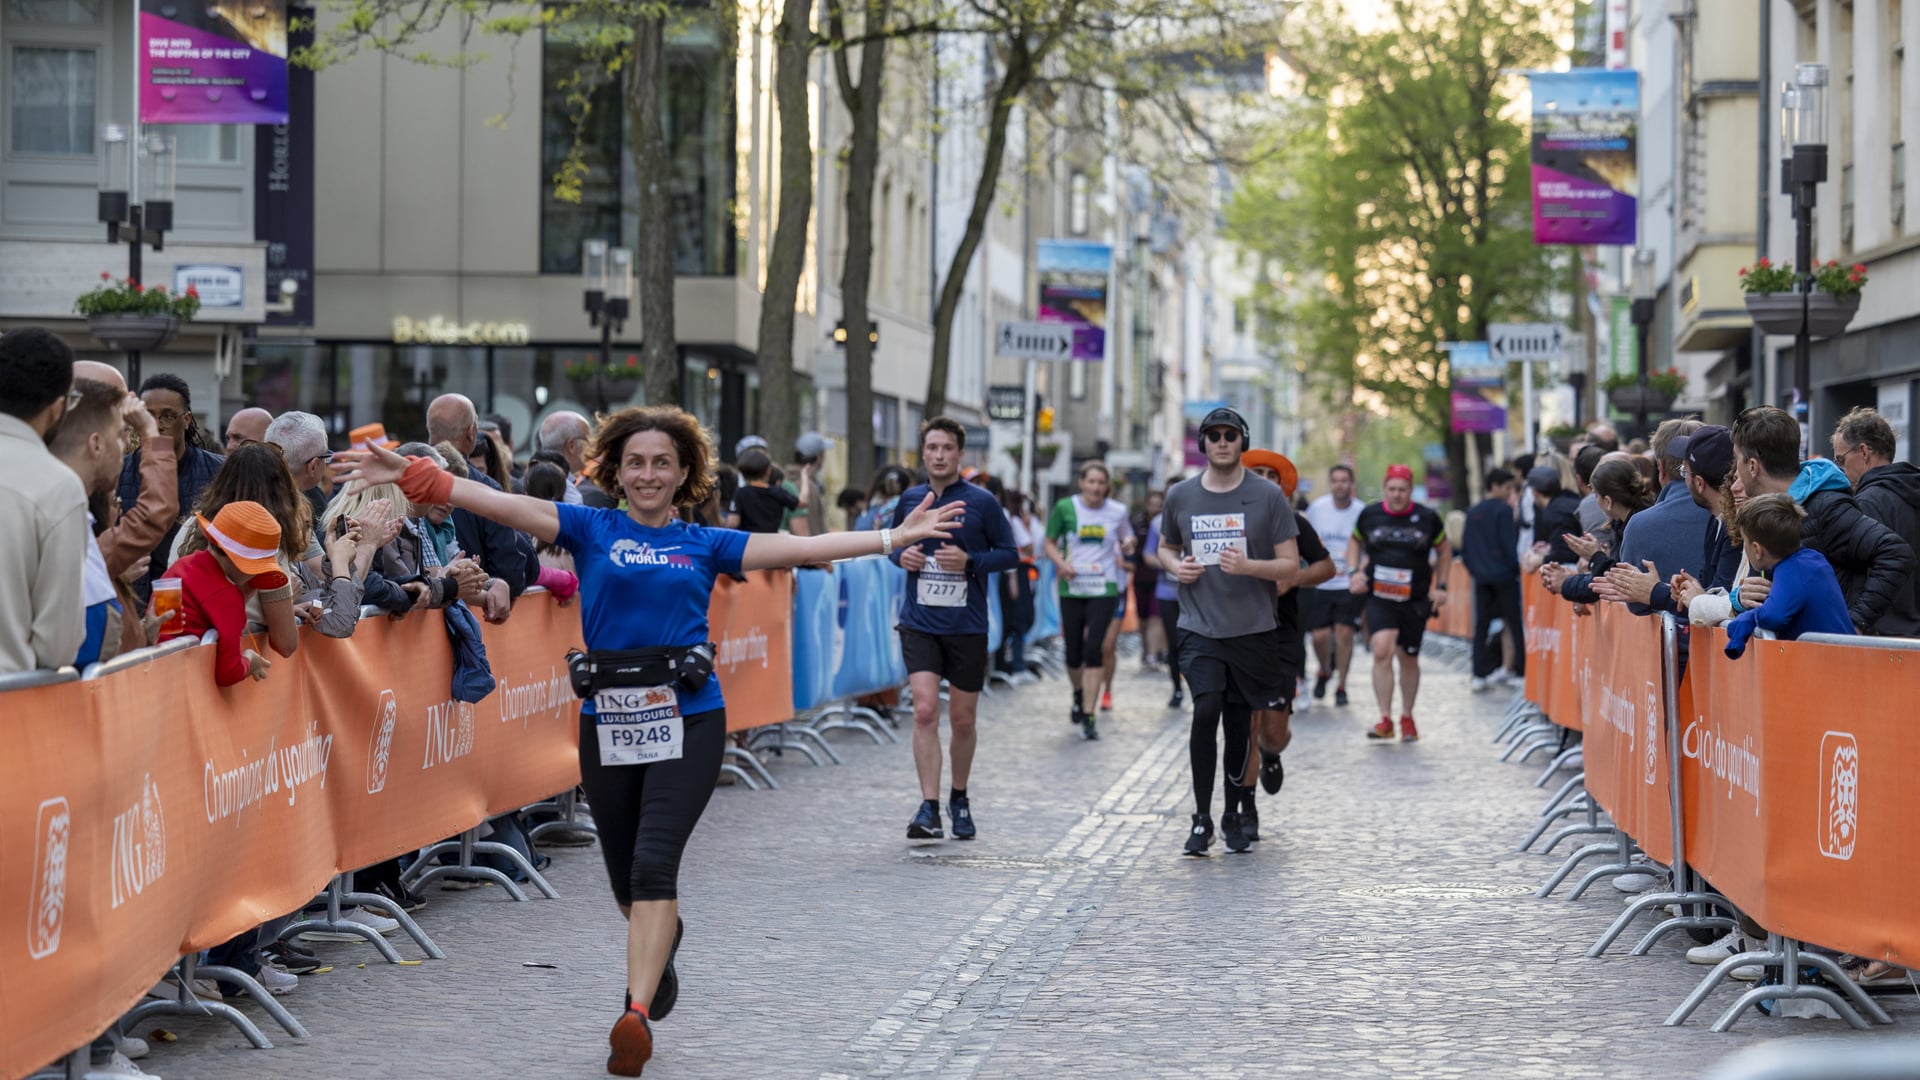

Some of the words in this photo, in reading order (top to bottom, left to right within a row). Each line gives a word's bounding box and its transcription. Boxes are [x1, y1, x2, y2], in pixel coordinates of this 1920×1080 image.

[149, 39, 168, 48] DIVE
[171, 39, 191, 48] INTO
[150, 49, 165, 58] THE
[168, 49, 198, 58] DEPTHS
[201, 49, 213, 58] OF
[215, 49, 231, 59] THE
[232, 50, 250, 59] CITY
[1194, 519, 1222, 529] ING
[624, 553, 669, 565] WORLD
[926, 583, 956, 596] 7277
[600, 694, 640, 710] ING
[600, 708, 674, 724] LUXEMBOURG
[421, 700, 456, 770] ING
[611, 724, 672, 747] F9248
[637, 752, 660, 761] DANA
[1715, 721, 1727, 780] do
[264, 736, 279, 796] do
[110, 802, 144, 910] ING
